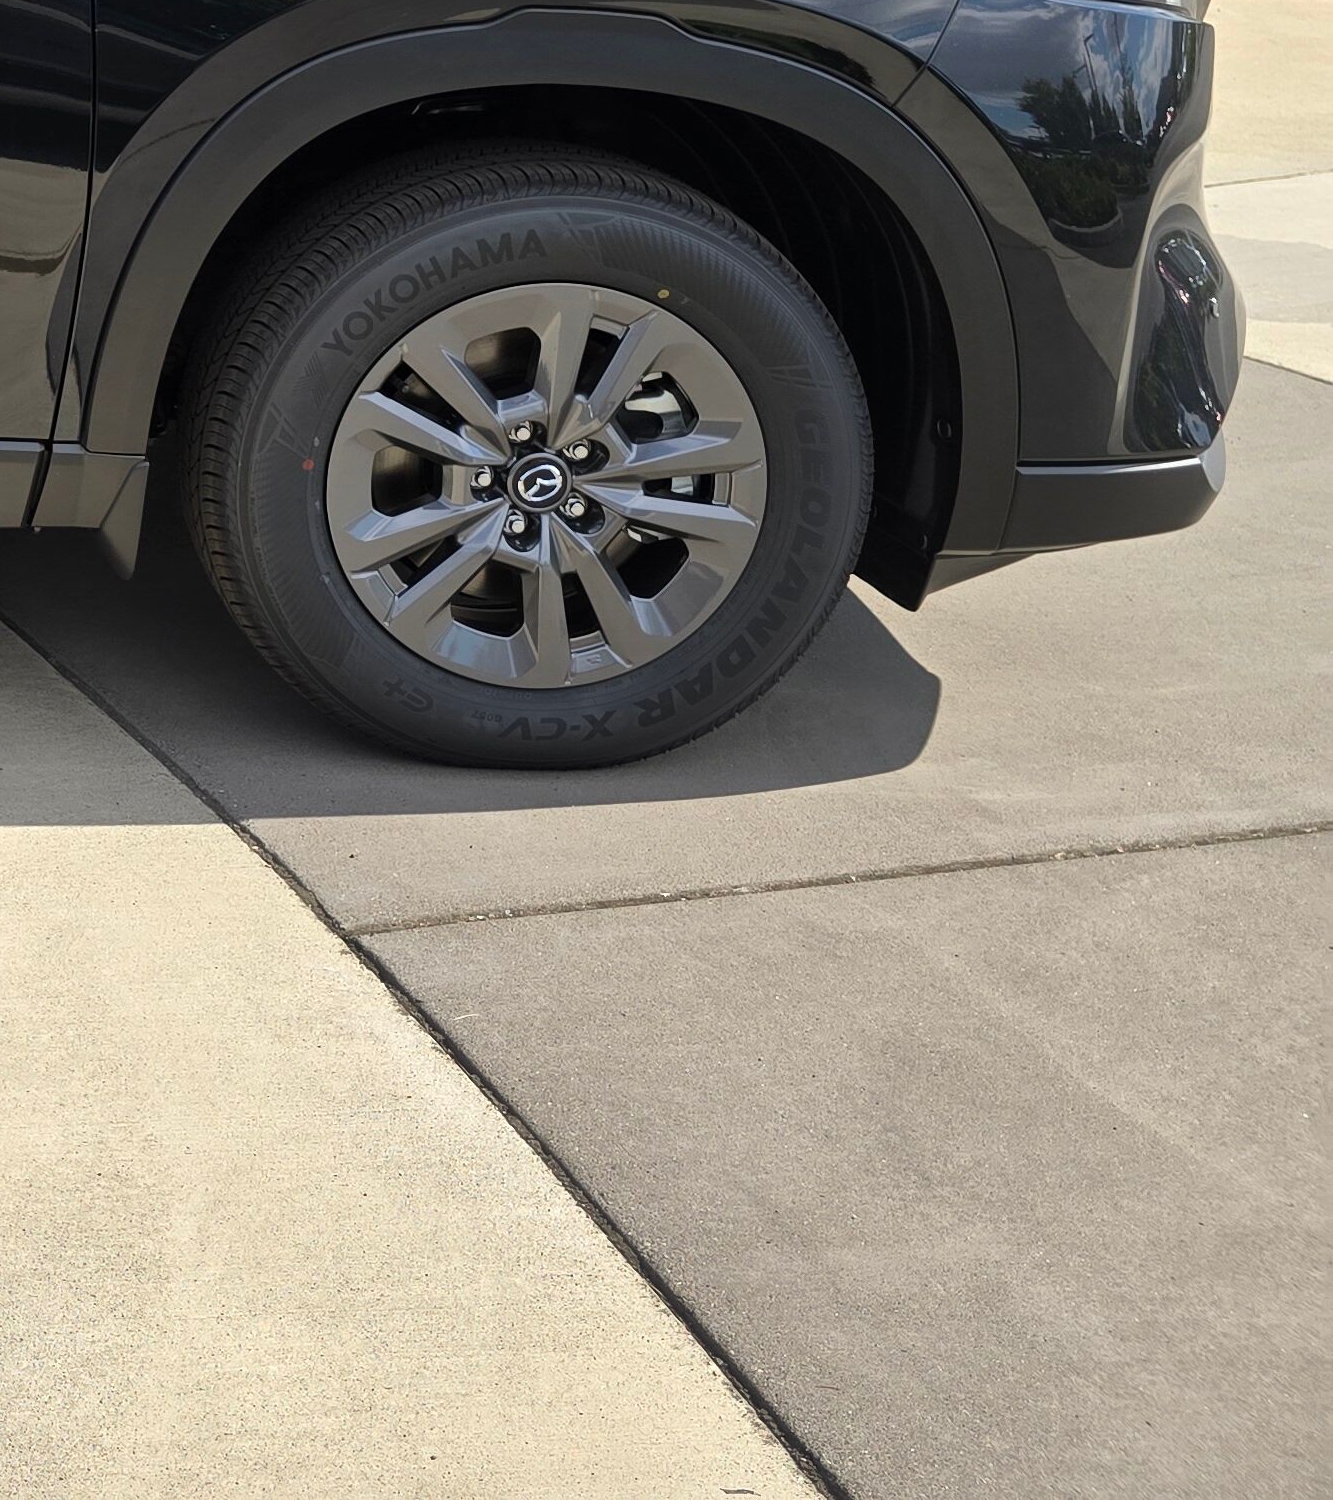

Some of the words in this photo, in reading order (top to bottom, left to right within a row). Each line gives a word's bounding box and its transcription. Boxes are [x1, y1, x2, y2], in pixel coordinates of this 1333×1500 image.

[320, 229, 548, 358] YOKOHAMA
[637, 410, 830, 729] GEOLANDAR
[498, 709, 617, 742] X-CV
